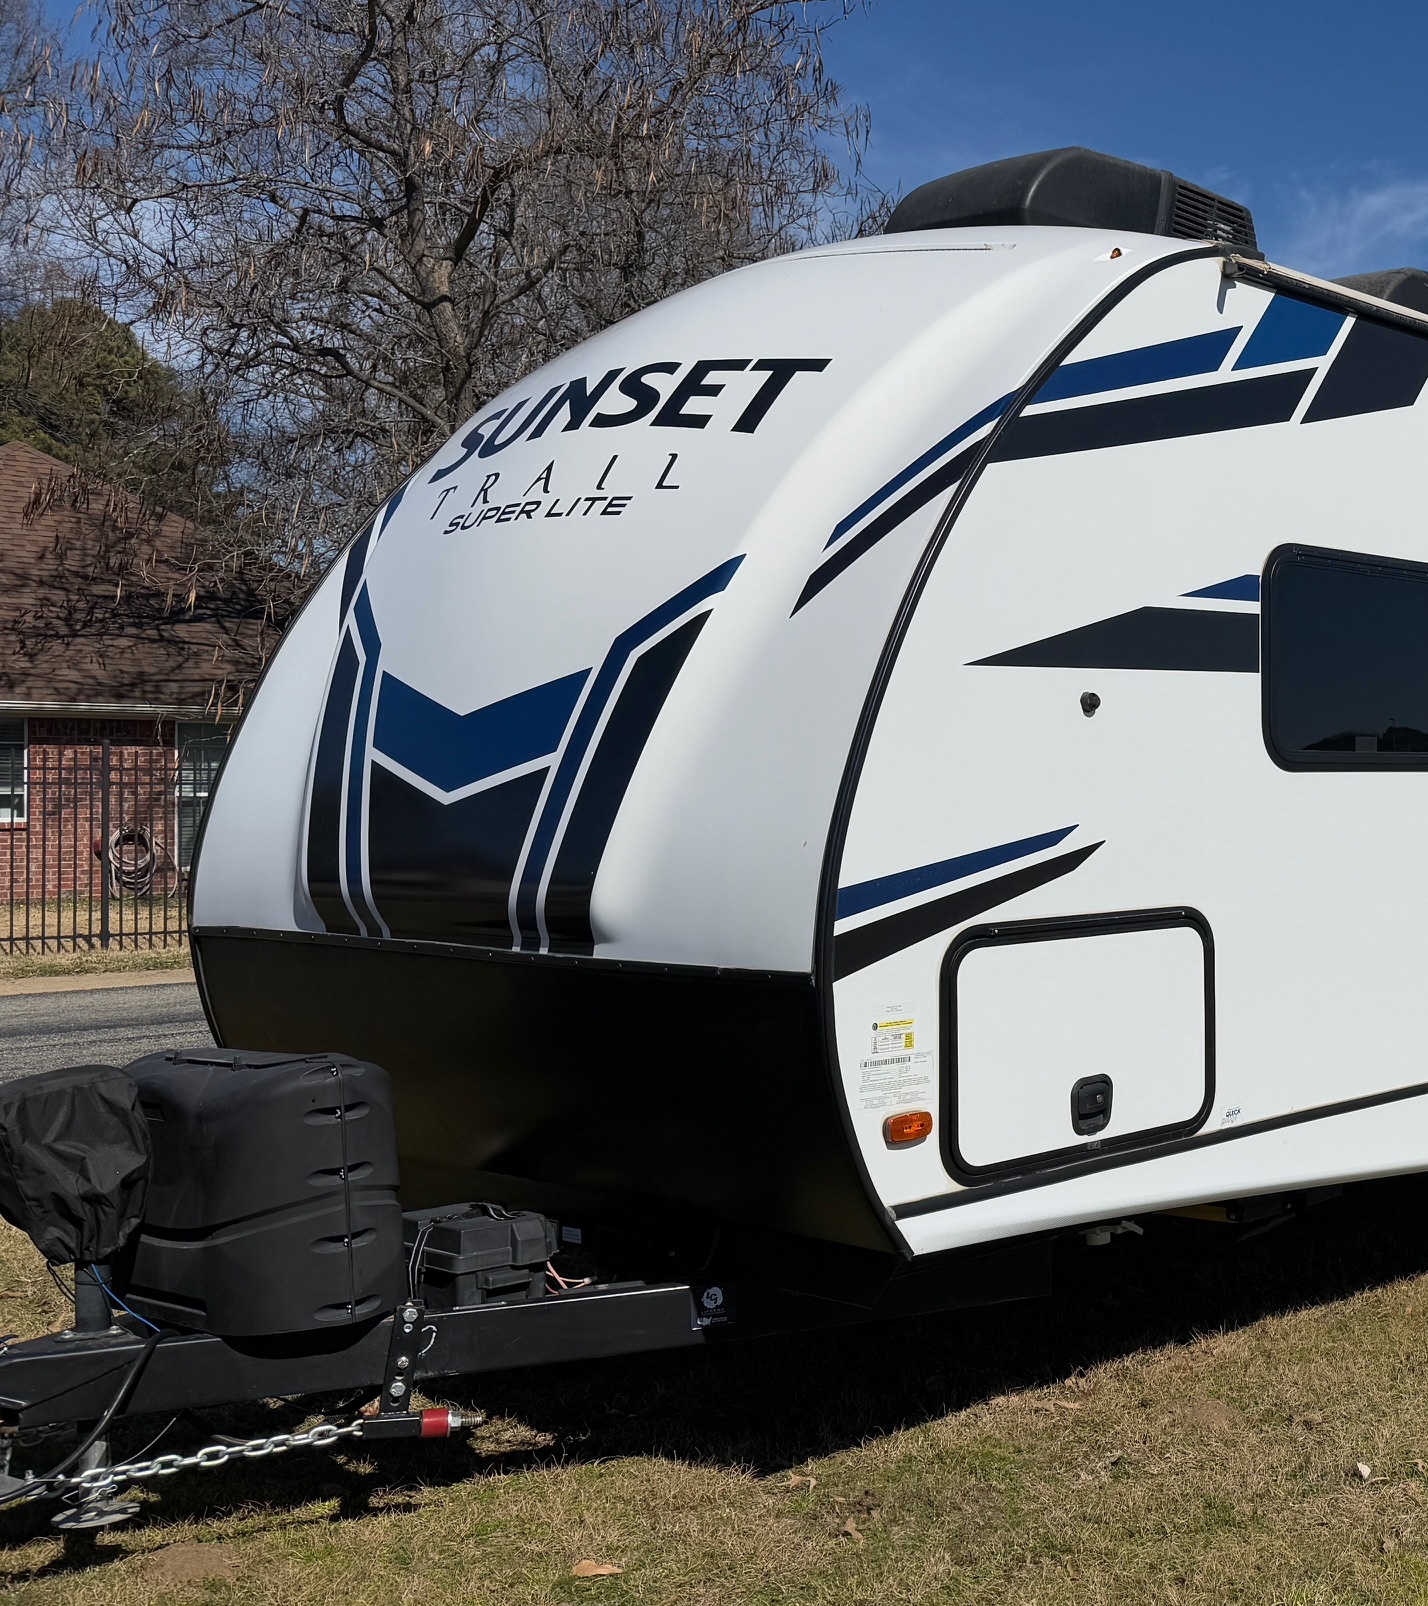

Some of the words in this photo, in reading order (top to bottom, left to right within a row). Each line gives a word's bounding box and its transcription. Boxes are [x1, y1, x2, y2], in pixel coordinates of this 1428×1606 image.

[429, 358, 832, 483] SUNSET
[430, 453, 680, 520] TRAIL
[443, 499, 543, 535] SUPER
[544, 496, 633, 518] LITE
